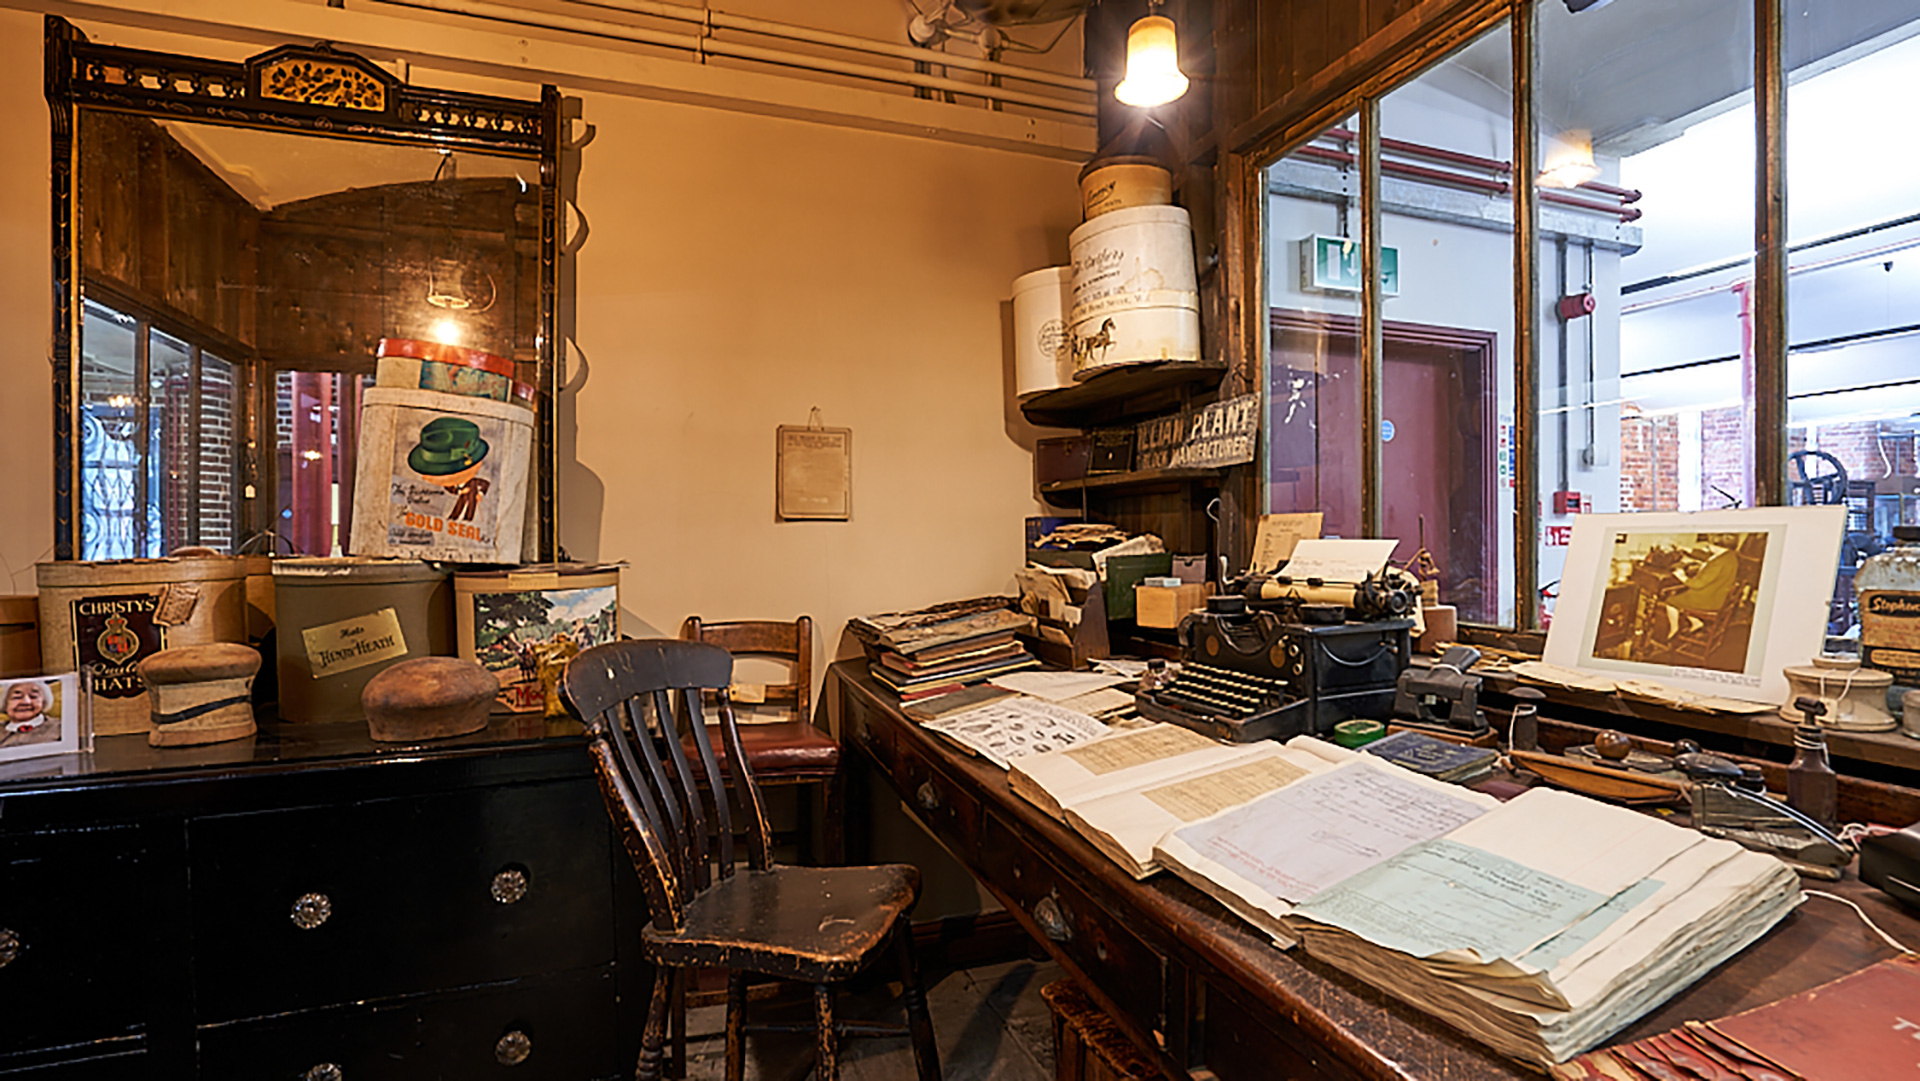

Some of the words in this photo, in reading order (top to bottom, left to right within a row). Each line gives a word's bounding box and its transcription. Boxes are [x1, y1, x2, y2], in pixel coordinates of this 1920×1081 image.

[1191, 401, 1253, 440] PLANT
[405, 512, 443, 532] GOLD
[447, 521, 482, 542] SEAL
